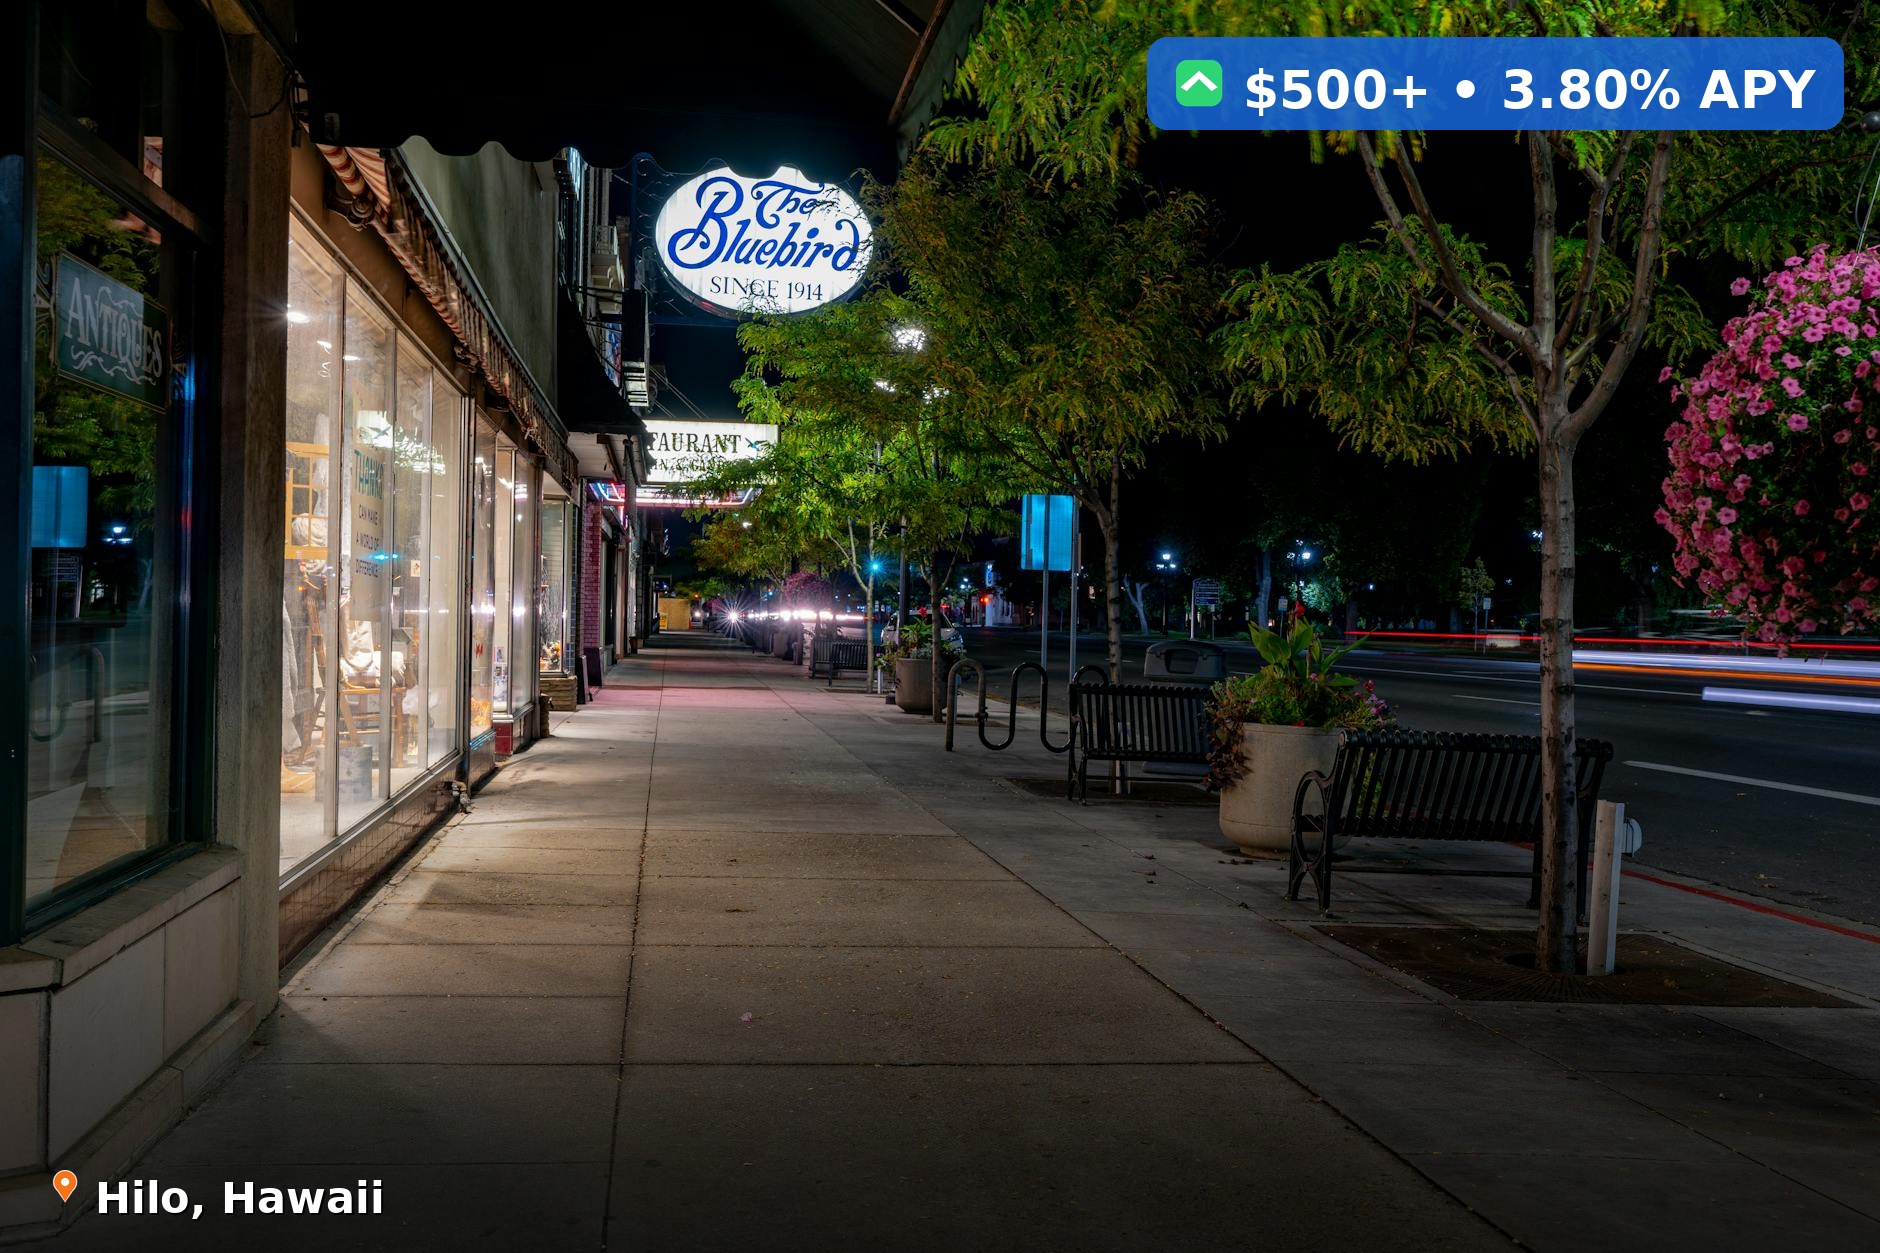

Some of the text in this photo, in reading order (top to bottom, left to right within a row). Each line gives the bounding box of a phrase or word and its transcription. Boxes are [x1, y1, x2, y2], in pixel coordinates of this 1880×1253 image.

[667, 176, 860, 272] Bluebird
[751, 181, 825, 229] The
[710, 275, 823, 300] SINCE 1914
